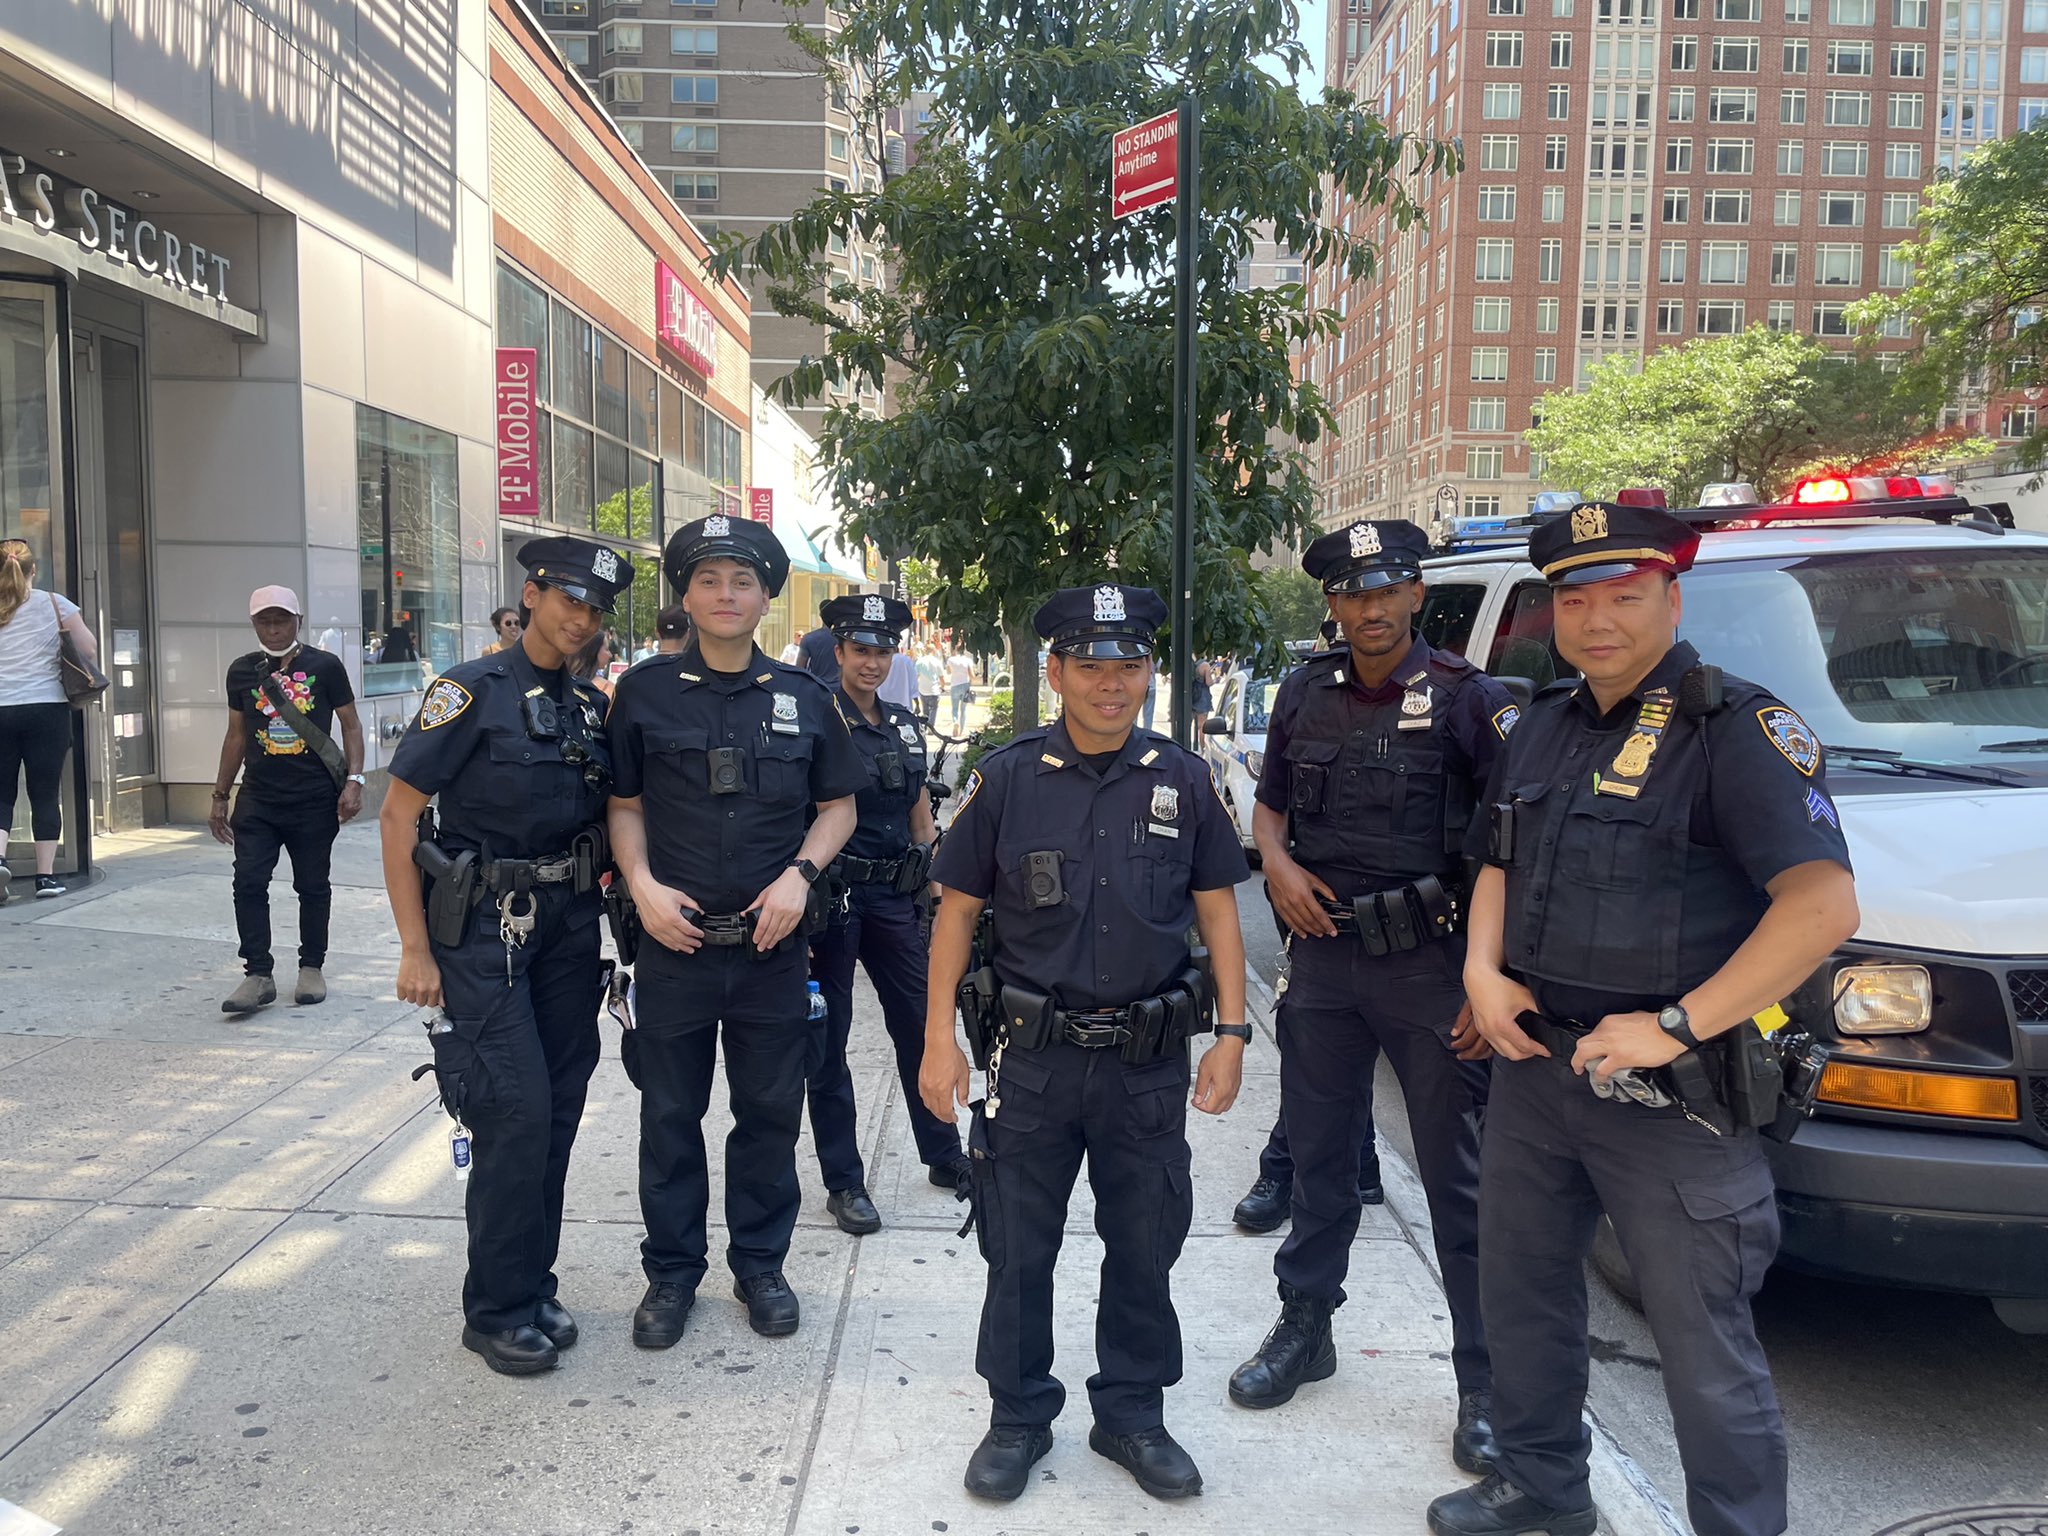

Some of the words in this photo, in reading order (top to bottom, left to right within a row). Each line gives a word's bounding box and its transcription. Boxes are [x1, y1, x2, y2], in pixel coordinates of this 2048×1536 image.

[1118, 139, 1131, 157] NO
[1118, 151, 1157, 176] Anytime
[80, 187, 230, 302] SECRET
[755, 493, 771, 530] bile
